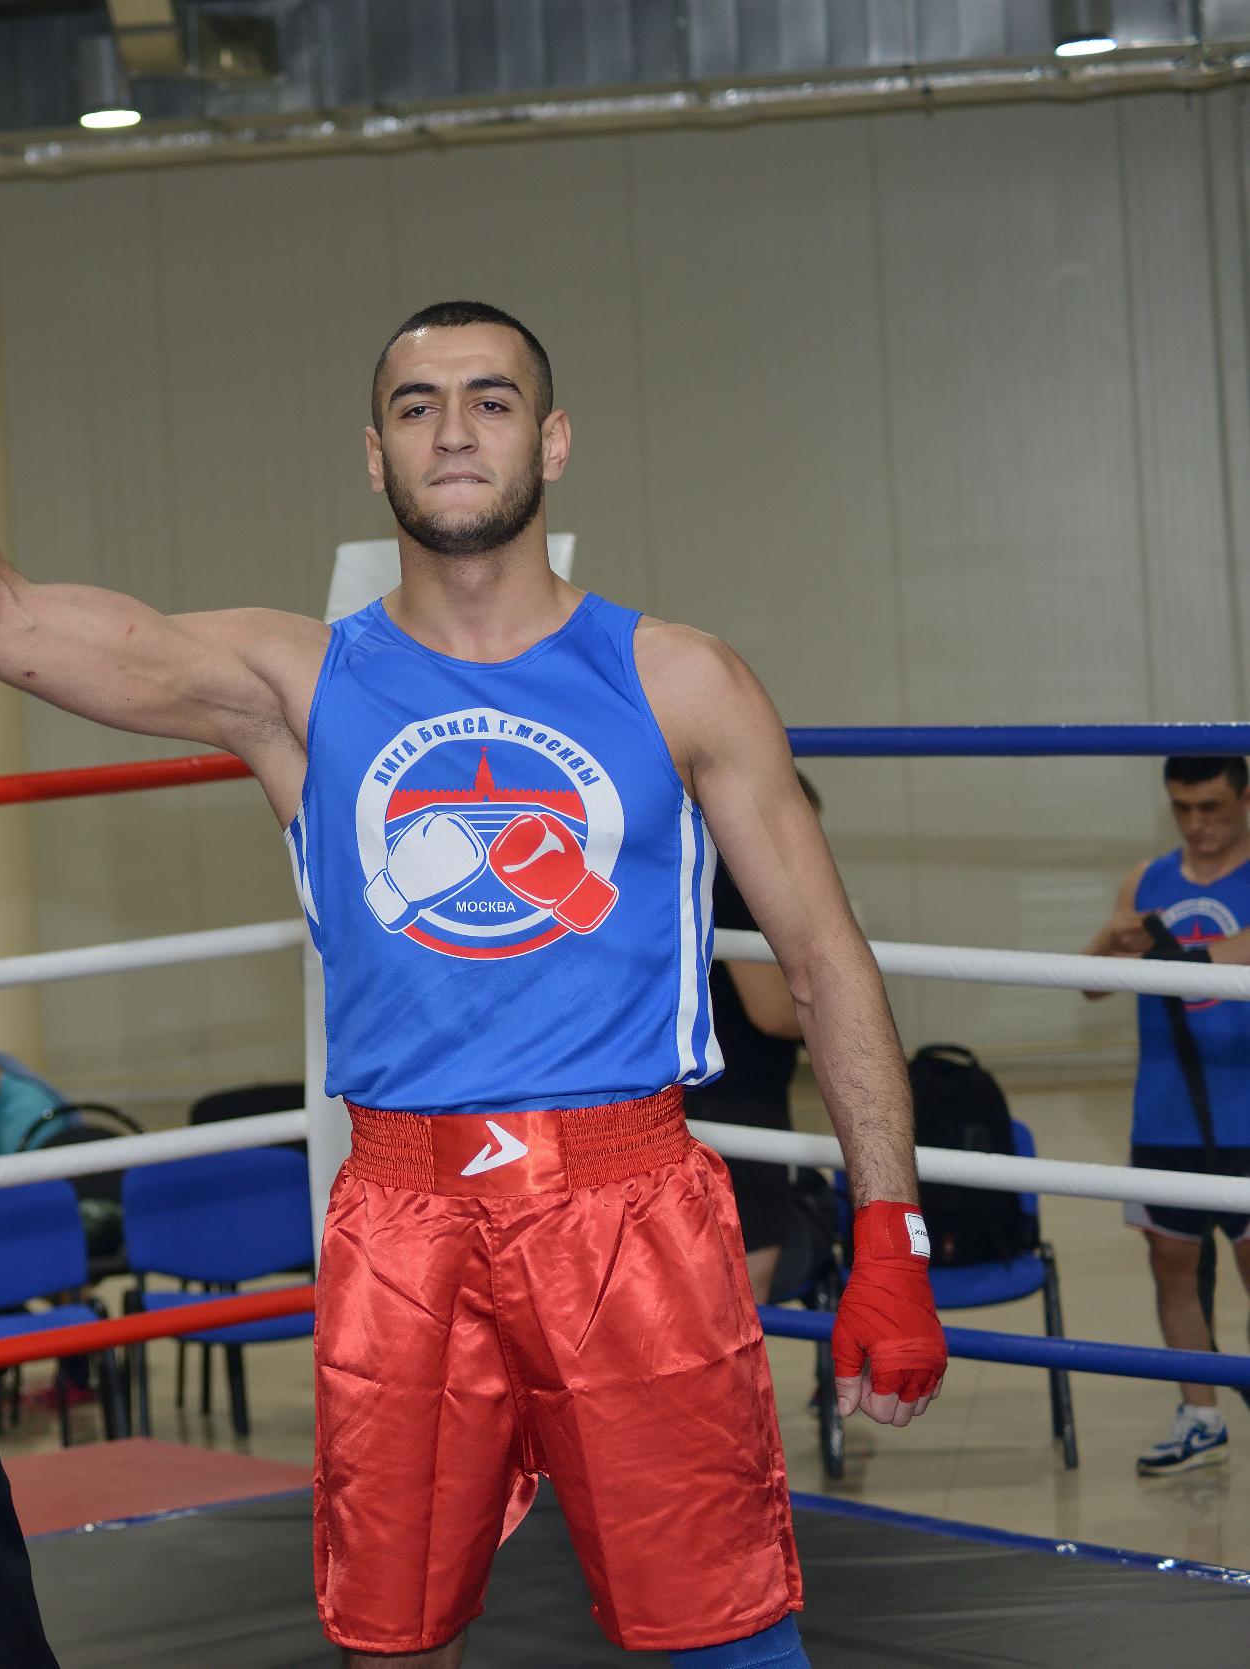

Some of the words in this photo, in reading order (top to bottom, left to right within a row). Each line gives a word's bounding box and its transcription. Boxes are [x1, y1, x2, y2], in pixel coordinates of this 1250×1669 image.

[373, 739, 418, 787] ЛИГА
[417, 715, 490, 743] БОКСА
[456, 901, 517, 913] МОСКВА
